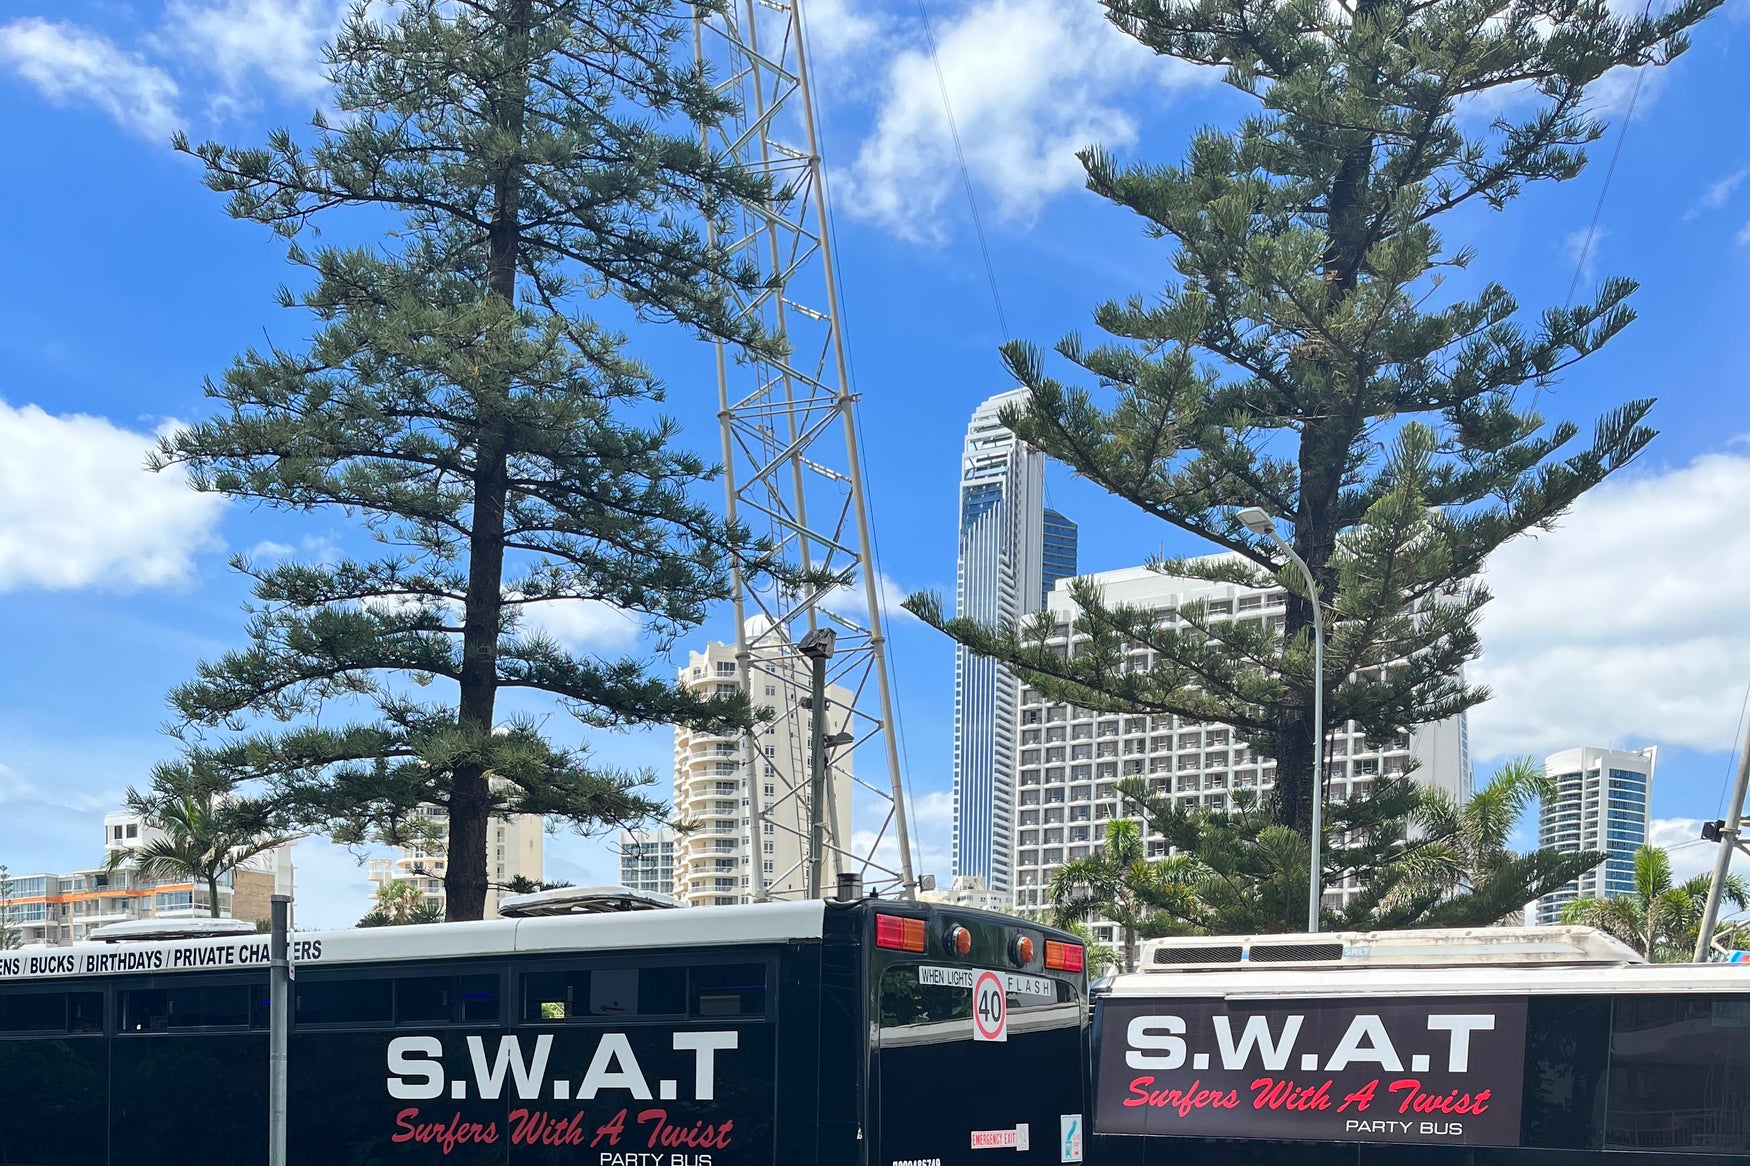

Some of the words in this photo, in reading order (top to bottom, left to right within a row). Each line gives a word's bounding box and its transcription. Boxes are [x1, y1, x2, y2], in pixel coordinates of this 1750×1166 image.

[30, 954, 75, 974] BUCKS
[86, 950, 163, 973] BIRTHDAYS
[174, 945, 235, 967] PRIVATE
[238, 939, 322, 964] CHAERS
[920, 967, 945, 984] WHEN
[947, 970, 973, 987] LIGHTS
[1007, 976, 1050, 995] FLASH
[978, 989, 1002, 1023] 40
[1125, 1014, 1496, 1073] S.W.A.T
[386, 1030, 739, 1101] S.W.A.T
[1122, 1075, 1241, 1118] Surfers
[1250, 1077, 1334, 1112] With
[1336, 1079, 1379, 1114] A
[1388, 1078, 1492, 1115] Twist
[391, 1107, 499, 1155] Surfers
[508, 1108, 585, 1146] With
[590, 1108, 628, 1149] A
[637, 1108, 734, 1149] Twist
[972, 1133, 1003, 1147] EMERGENCY
[1004, 1132, 1016, 1145] EXIT
[1345, 1119, 1413, 1135] PARTY
[1419, 1121, 1463, 1136] BUS
